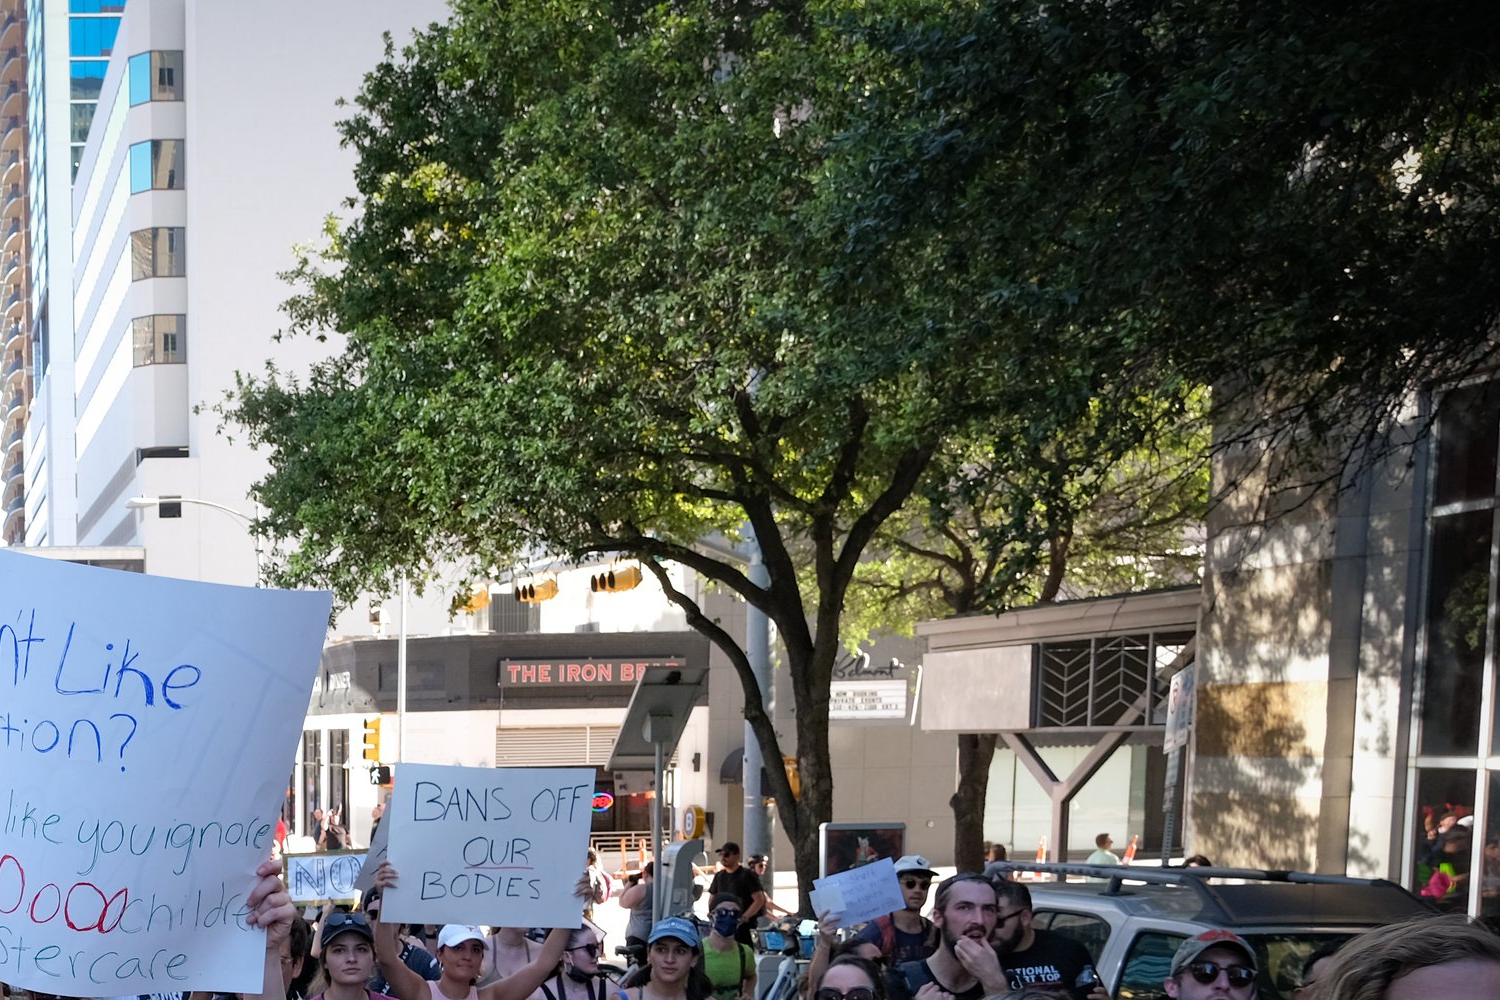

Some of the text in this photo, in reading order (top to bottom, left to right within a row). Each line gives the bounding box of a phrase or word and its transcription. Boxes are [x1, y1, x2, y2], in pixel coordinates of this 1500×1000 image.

[54, 620, 202, 711] Like
[507, 663, 678, 683] THE IRON BE
[4, 788, 64, 845] like
[413, 780, 513, 823] BANS
[530, 783, 590, 824] OFF
[462, 836, 533, 868] OUR
[420, 870, 542, 902] BODIES
[1040, 973, 1060, 983] TOP
